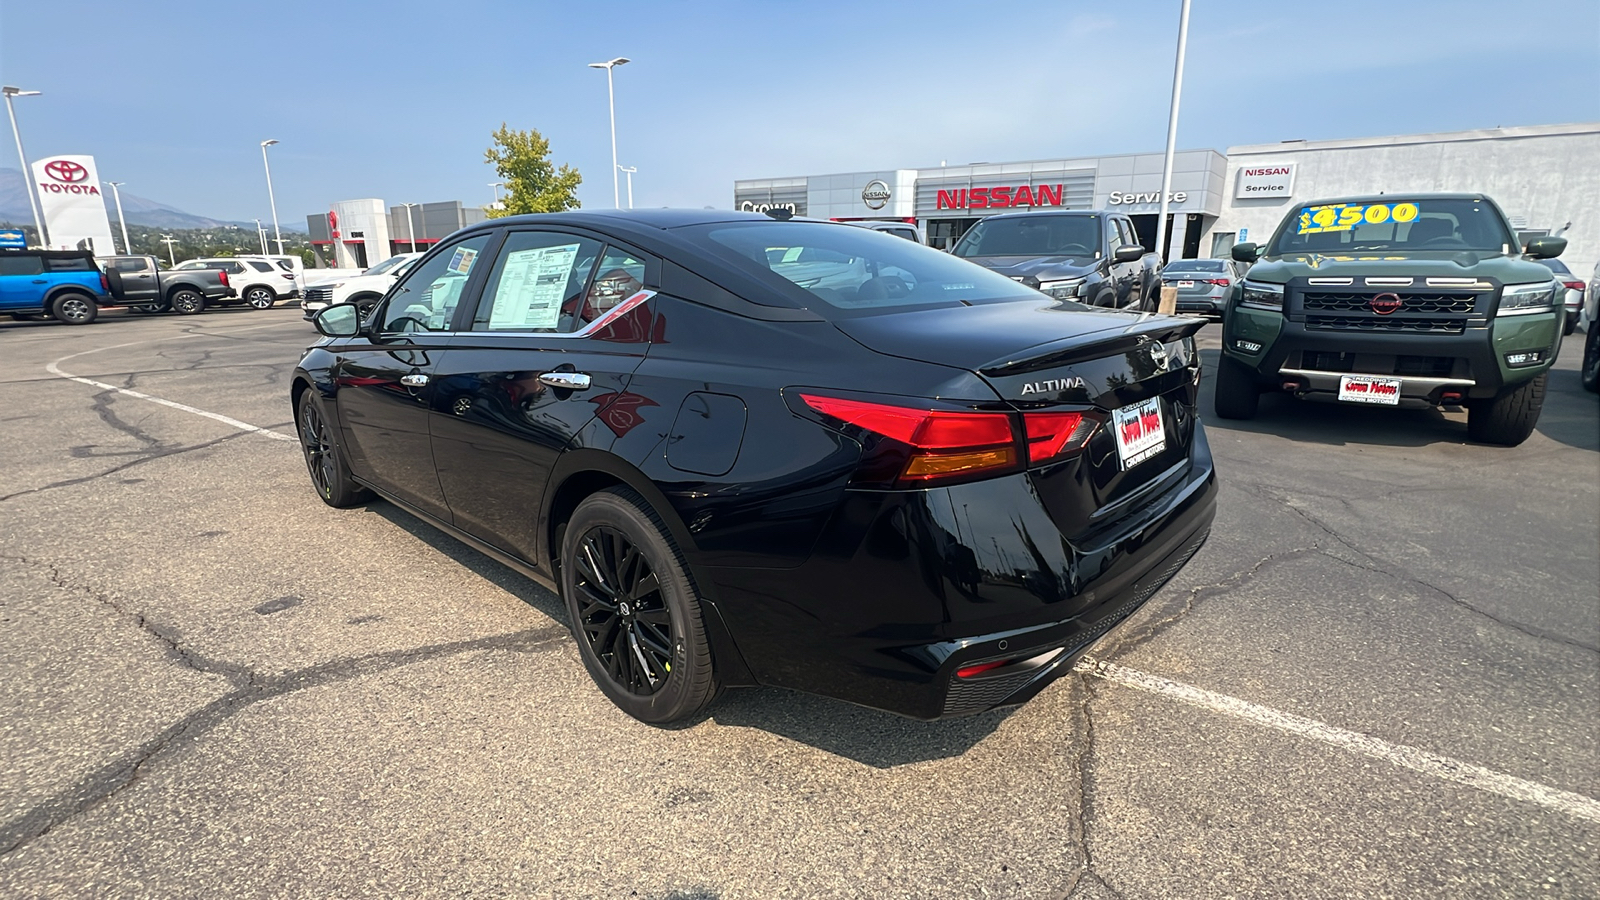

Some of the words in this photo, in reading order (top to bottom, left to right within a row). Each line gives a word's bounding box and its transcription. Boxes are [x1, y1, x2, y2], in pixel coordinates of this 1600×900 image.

[1245, 168, 1290, 176] NISSAN
[40, 183, 100, 196] TOYOTA
[937, 184, 1063, 209] NISSAN
[1300, 203, 1418, 229] $4500
[1021, 376, 1086, 396] ALTIMA
[1345, 381, 1368, 392] Crown
[1370, 381, 1397, 395] Motors
[1120, 415, 1141, 446] Crown
[1140, 407, 1160, 437] Motors
[1126, 451, 1146, 468] CROWN
[1145, 443, 1166, 459] MOTORS
[671, 636, 685, 694] KUMHO
